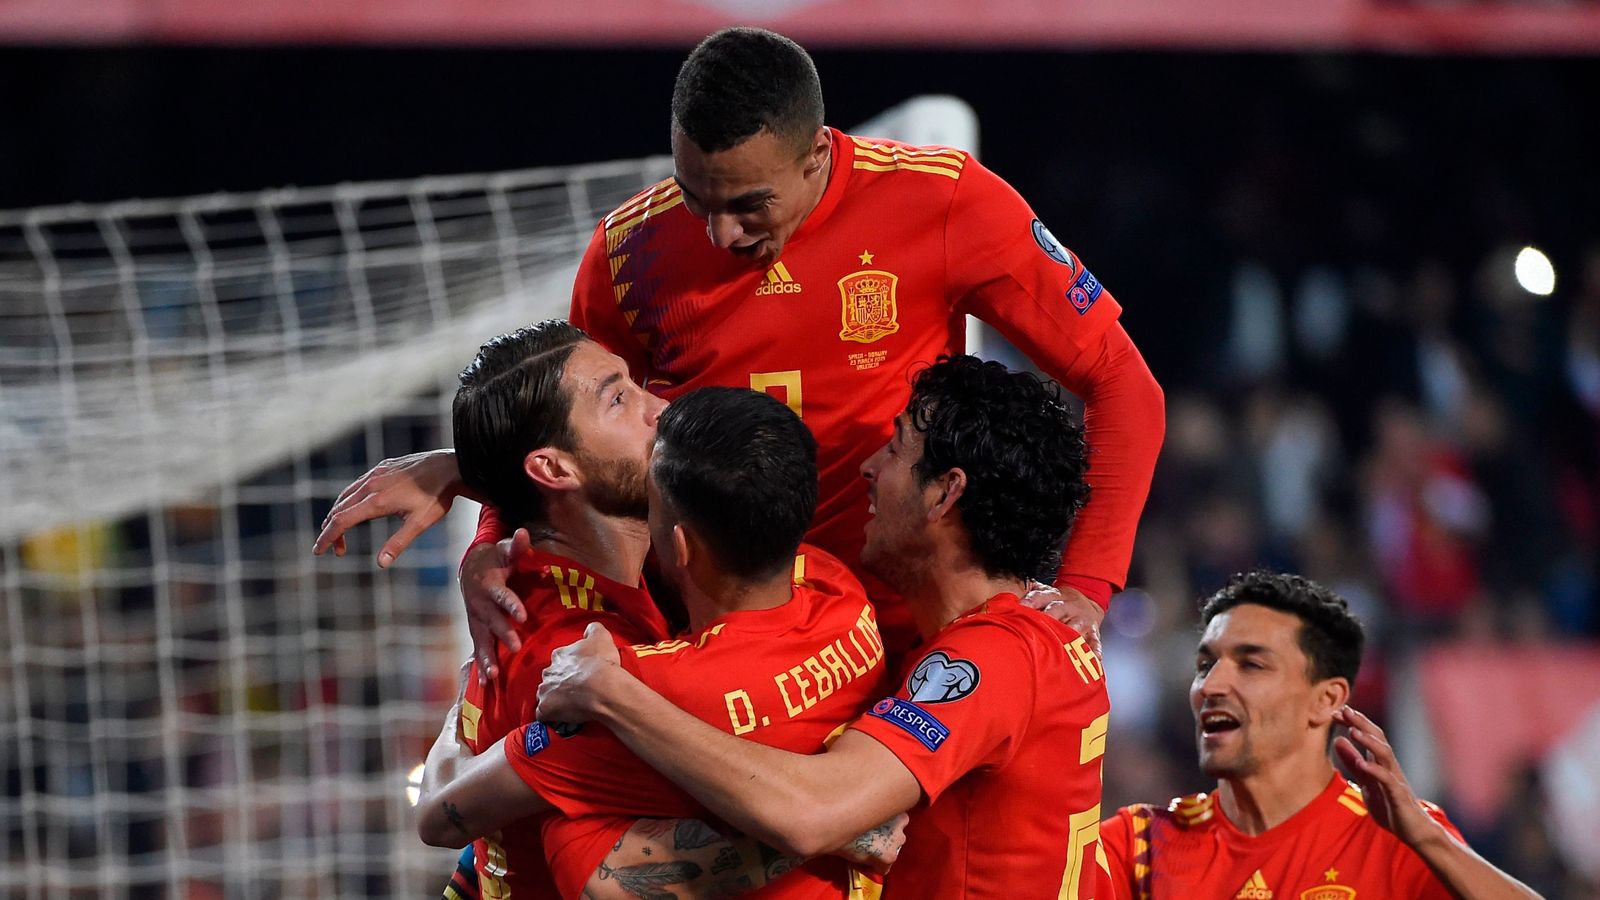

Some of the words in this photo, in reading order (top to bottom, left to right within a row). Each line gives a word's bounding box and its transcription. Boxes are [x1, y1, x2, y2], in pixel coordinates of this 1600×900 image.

[755, 280, 802, 297] adidas
[723, 688, 771, 736] D.
[889, 704, 946, 745] RESPECT
